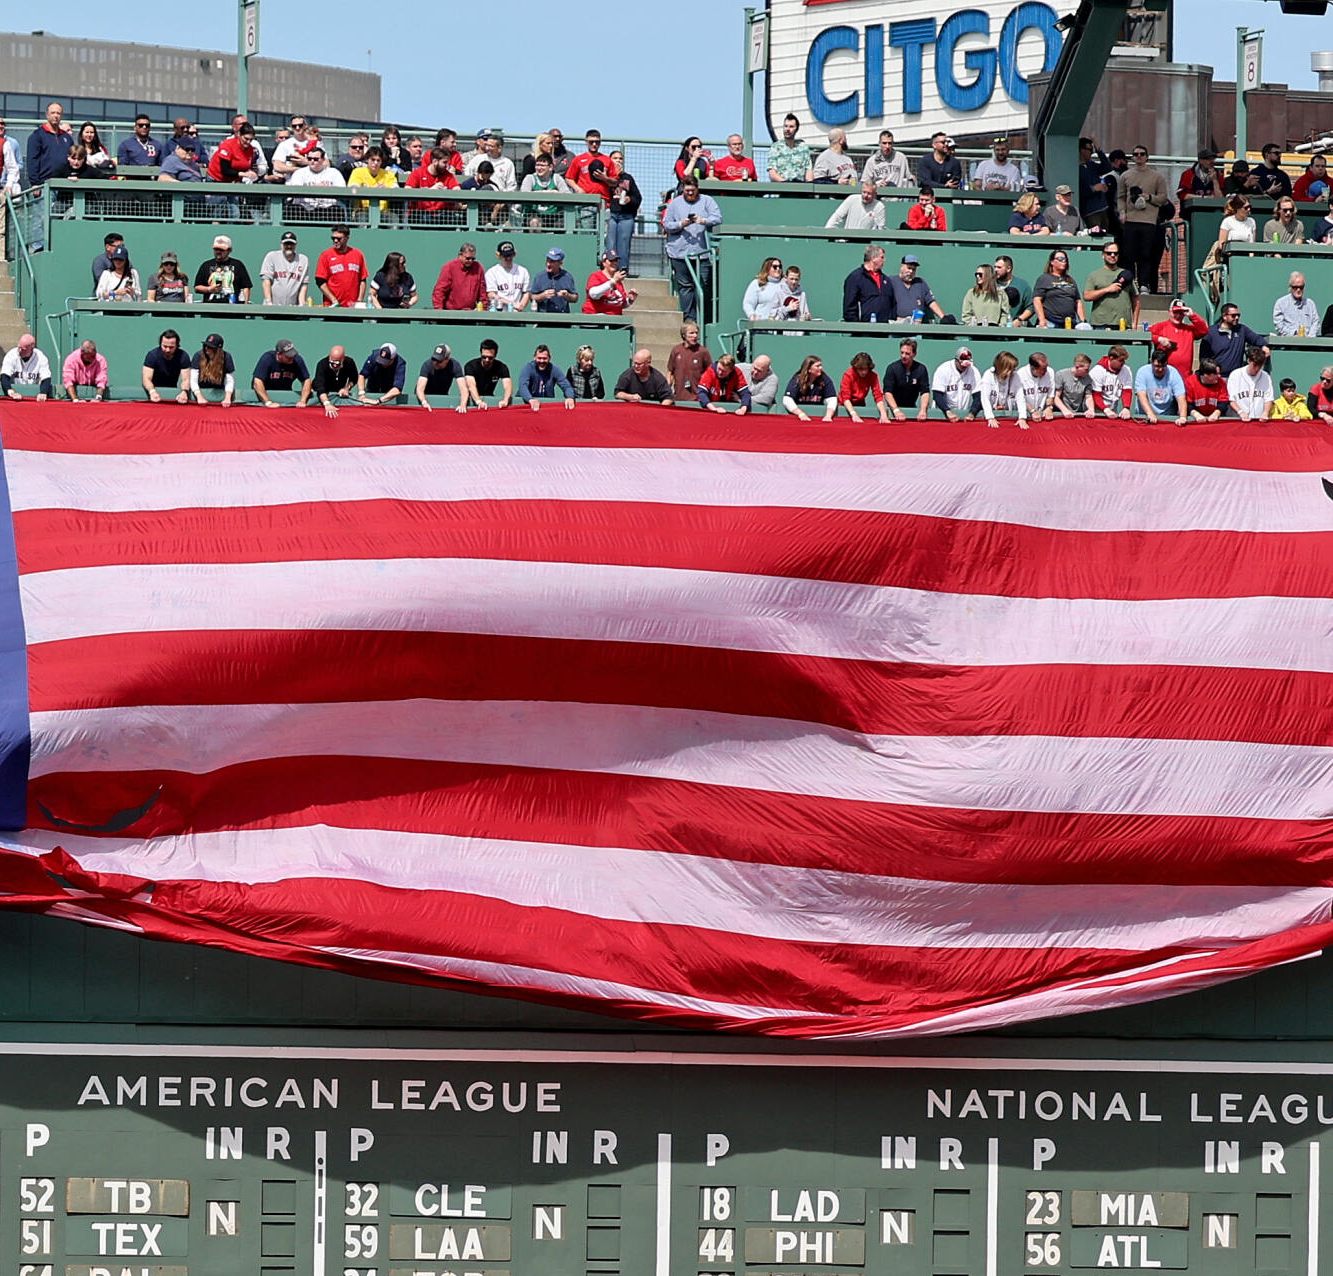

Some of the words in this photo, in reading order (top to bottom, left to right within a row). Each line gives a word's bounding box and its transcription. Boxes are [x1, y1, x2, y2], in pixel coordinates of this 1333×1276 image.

[806, 1, 1063, 125] CITGO
[1248, 61, 1254, 82] 8
[874, 165, 901, 176] BOSTON
[78, 1076, 339, 1109] AMERICAN
[372, 1080, 560, 1112] LEAGUE
[928, 1089, 1162, 1121] NATIONAL
[27, 1124, 49, 1156] P
[206, 1127, 242, 1160] IN
[267, 1127, 290, 1159] R
[351, 1128, 374, 1162] P
[533, 1131, 567, 1164] IN
[594, 1130, 618, 1165] R
[707, 1133, 729, 1166] P
[882, 1136, 916, 1169] IN
[940, 1138, 965, 1171] R
[1034, 1138, 1056, 1171] P
[1205, 1141, 1239, 1174] IN
[1262, 1142, 1286, 1174] R
[21, 1178, 54, 1212] 52
[104, 1182, 151, 1214] TB
[345, 1183, 378, 1217] 32
[415, 1184, 487, 1217] CLE
[704, 1187, 730, 1221] 18
[771, 1190, 839, 1222] LAD
[1027, 1192, 1059, 1225] 23
[1101, 1194, 1158, 1226] MIA
[209, 1202, 236, 1235] N
[536, 1207, 562, 1240] N
[883, 1211, 908, 1244] N
[1208, 1215, 1229, 1248] N
[23, 1220, 51, 1255] 51
[92, 1223, 162, 1256] TEX
[345, 1225, 378, 1259] 59
[415, 1228, 484, 1260] LAA
[700, 1229, 733, 1263] 44
[776, 1232, 833, 1264] PHI
[1027, 1234, 1060, 1266] 56
[1098, 1236, 1161, 1268] ATL
